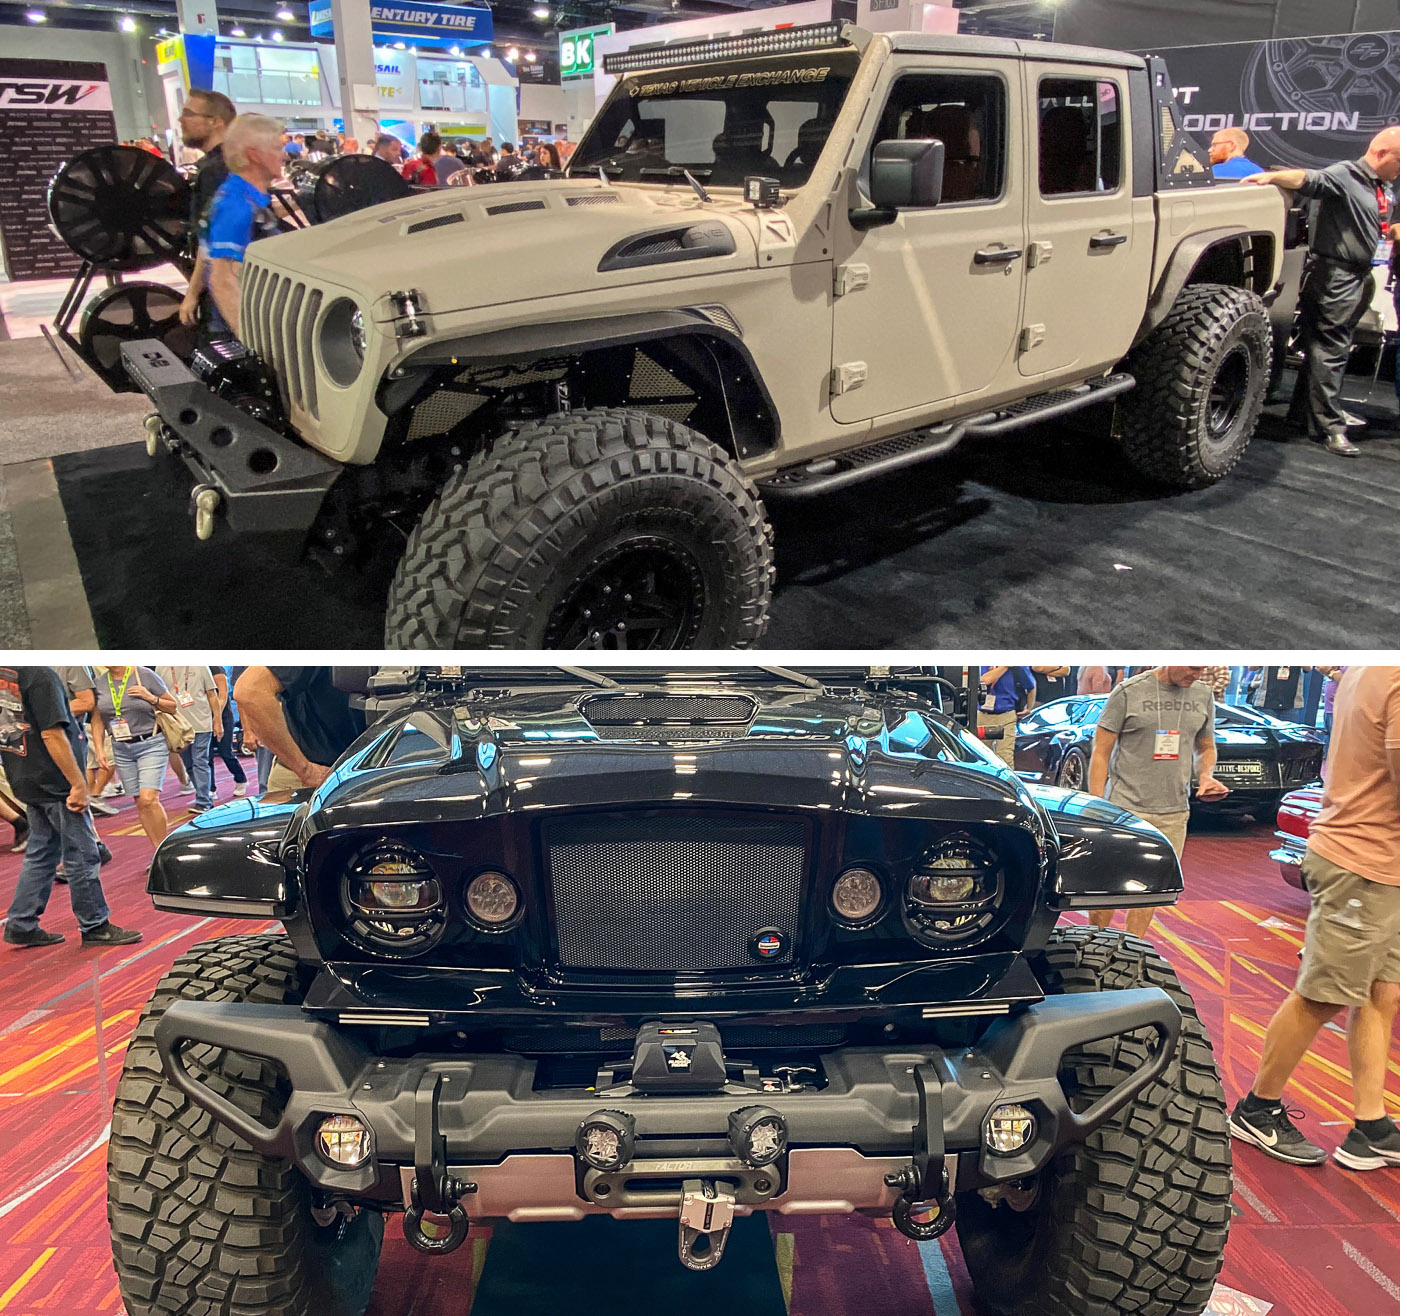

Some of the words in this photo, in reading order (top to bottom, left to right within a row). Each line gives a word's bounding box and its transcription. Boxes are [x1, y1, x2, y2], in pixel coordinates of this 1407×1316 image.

[371, 8, 436, 27] ENTURY
[441, 14, 476, 27] TIRE
[639, 81, 678, 96] TEXAS
[680, 75, 738, 93] VEHICLE
[736, 67, 830, 87] EXCHANGE
[0, 83, 99, 105] TSW
[1184, 111, 1360, 131] ODUCTION
[1142, 700, 1200, 713] Reebok
